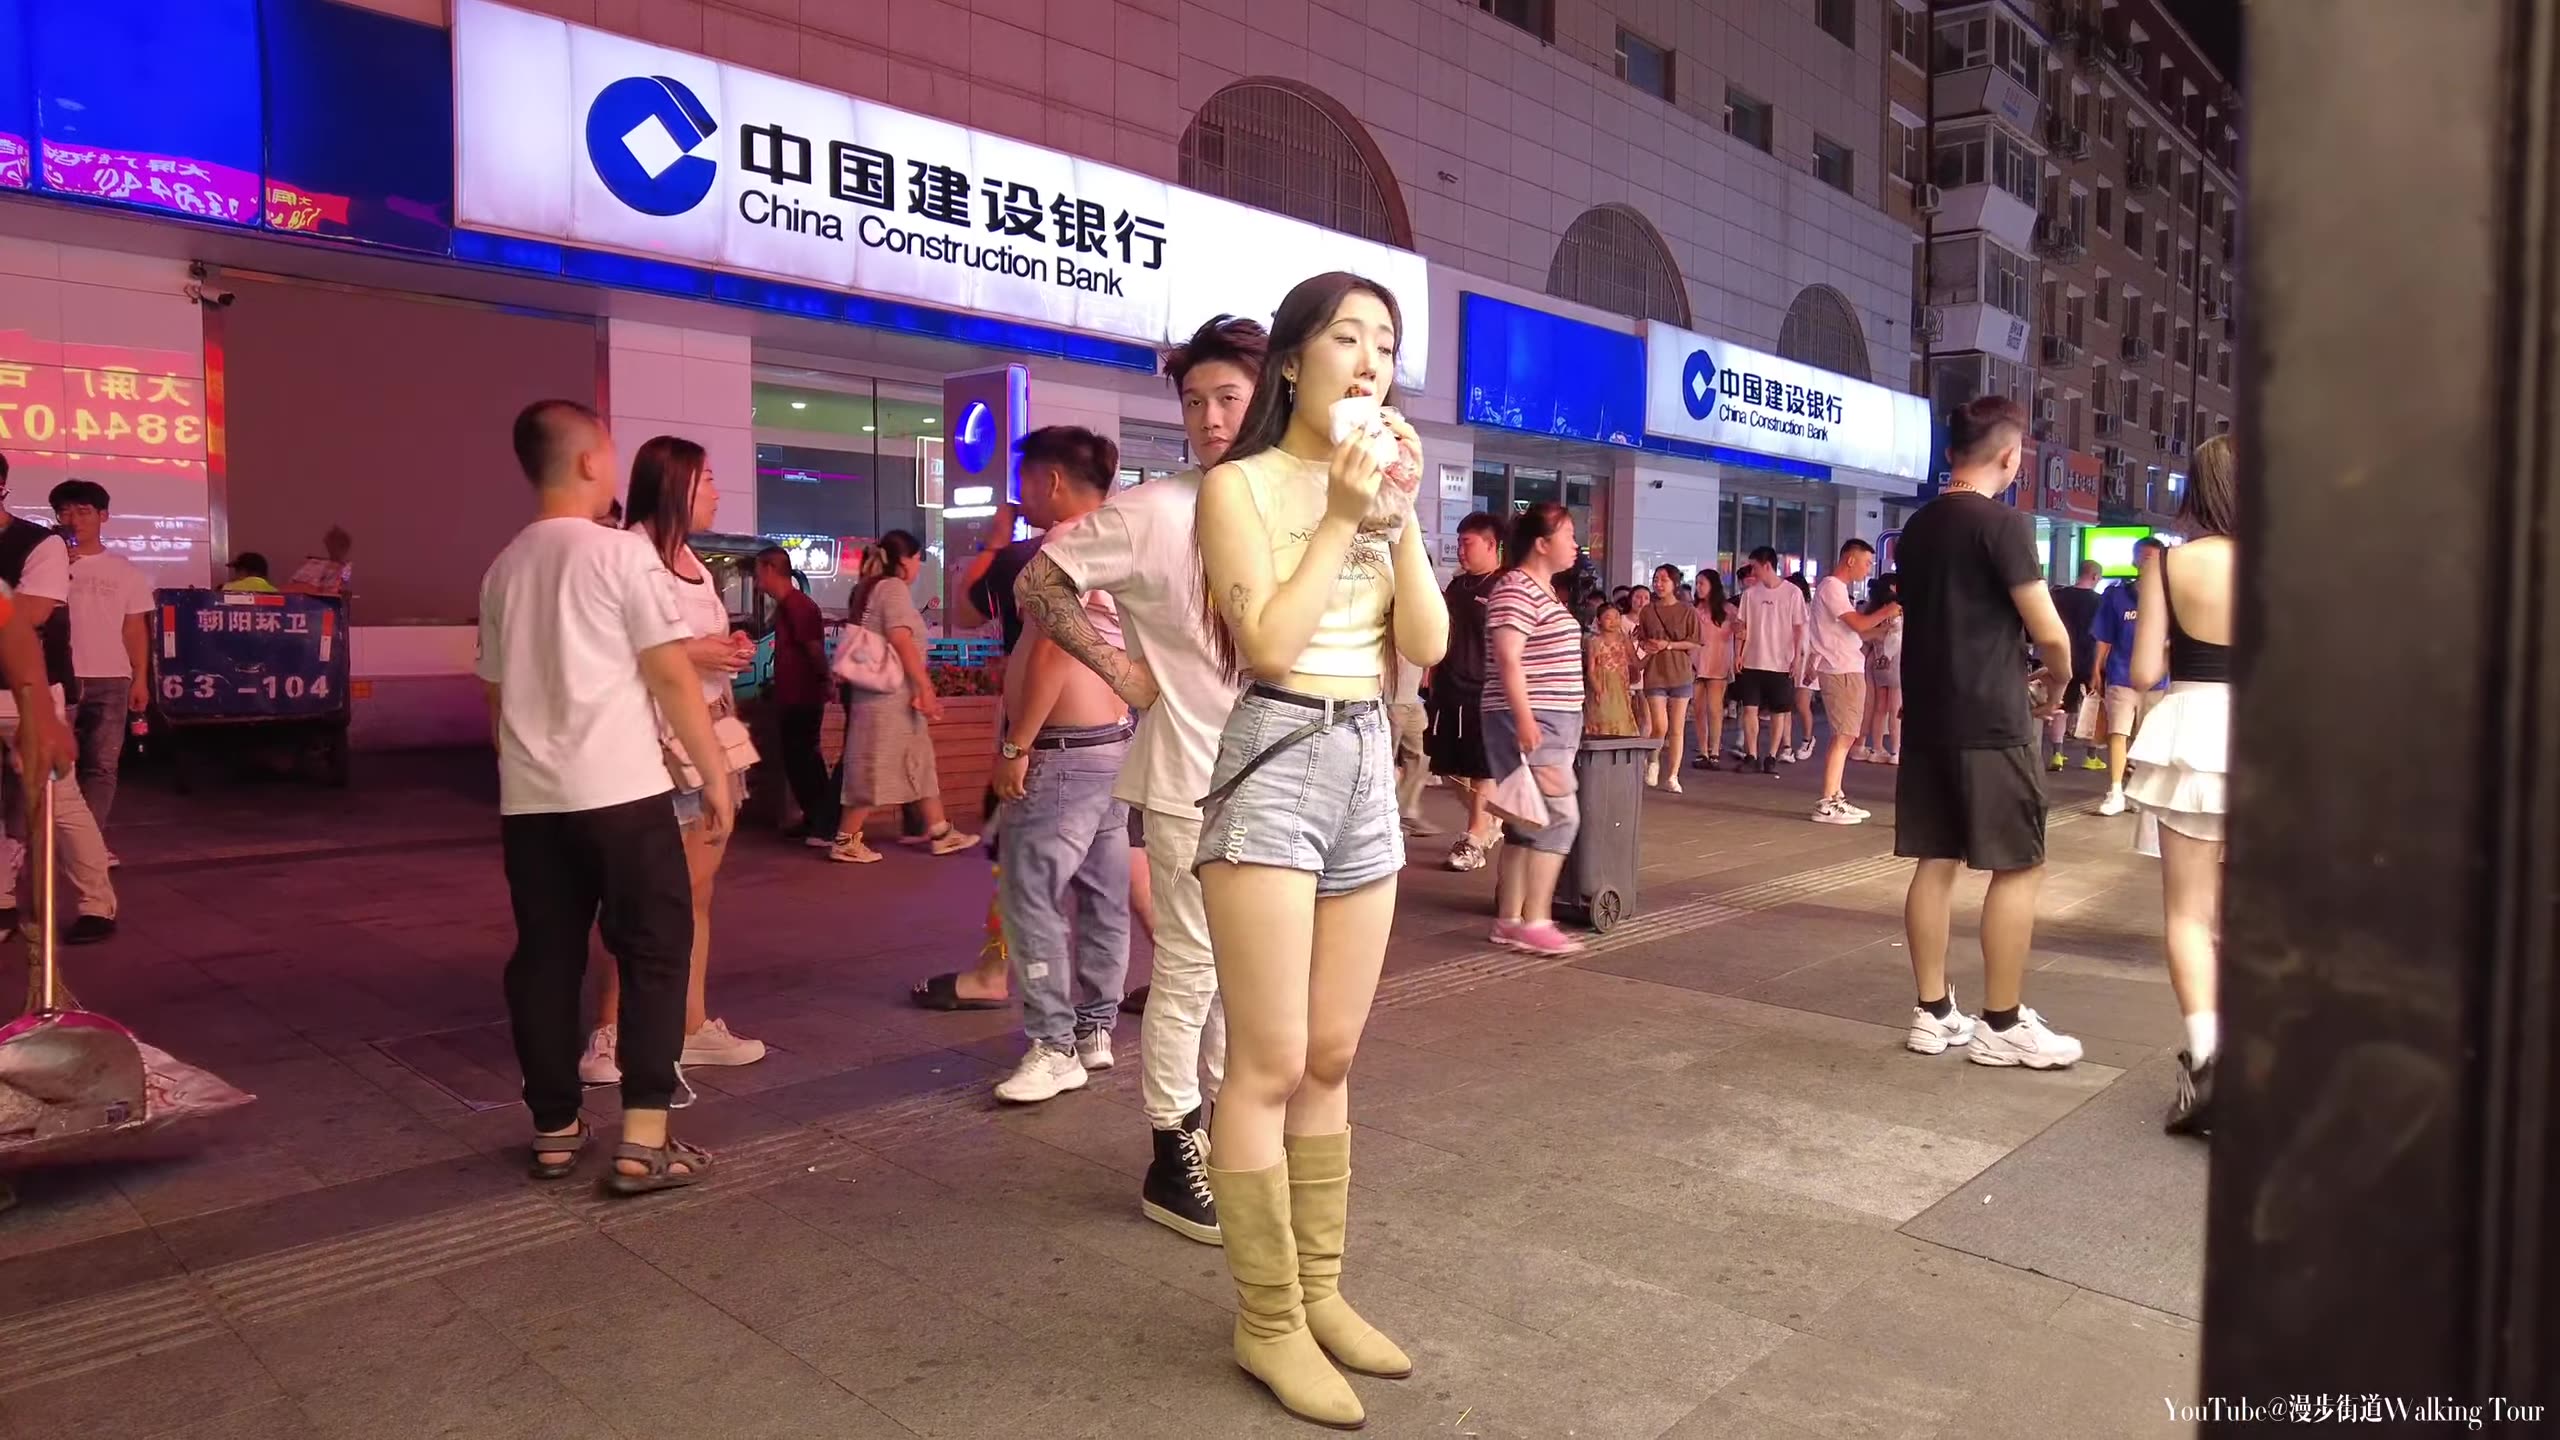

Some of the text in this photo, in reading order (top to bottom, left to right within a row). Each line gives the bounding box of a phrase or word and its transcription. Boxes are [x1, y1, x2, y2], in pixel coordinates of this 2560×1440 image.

[740, 123, 1168, 271] 中国建设银行
[738, 190, 1125, 298] China Construction Bank
[1720, 368, 1843, 424] 中国建设银行
[1719, 403, 1829, 442] China Construction Bank
[197, 609, 308, 633] 朝阳环卫
[2123, 610, 2138, 621] RO
